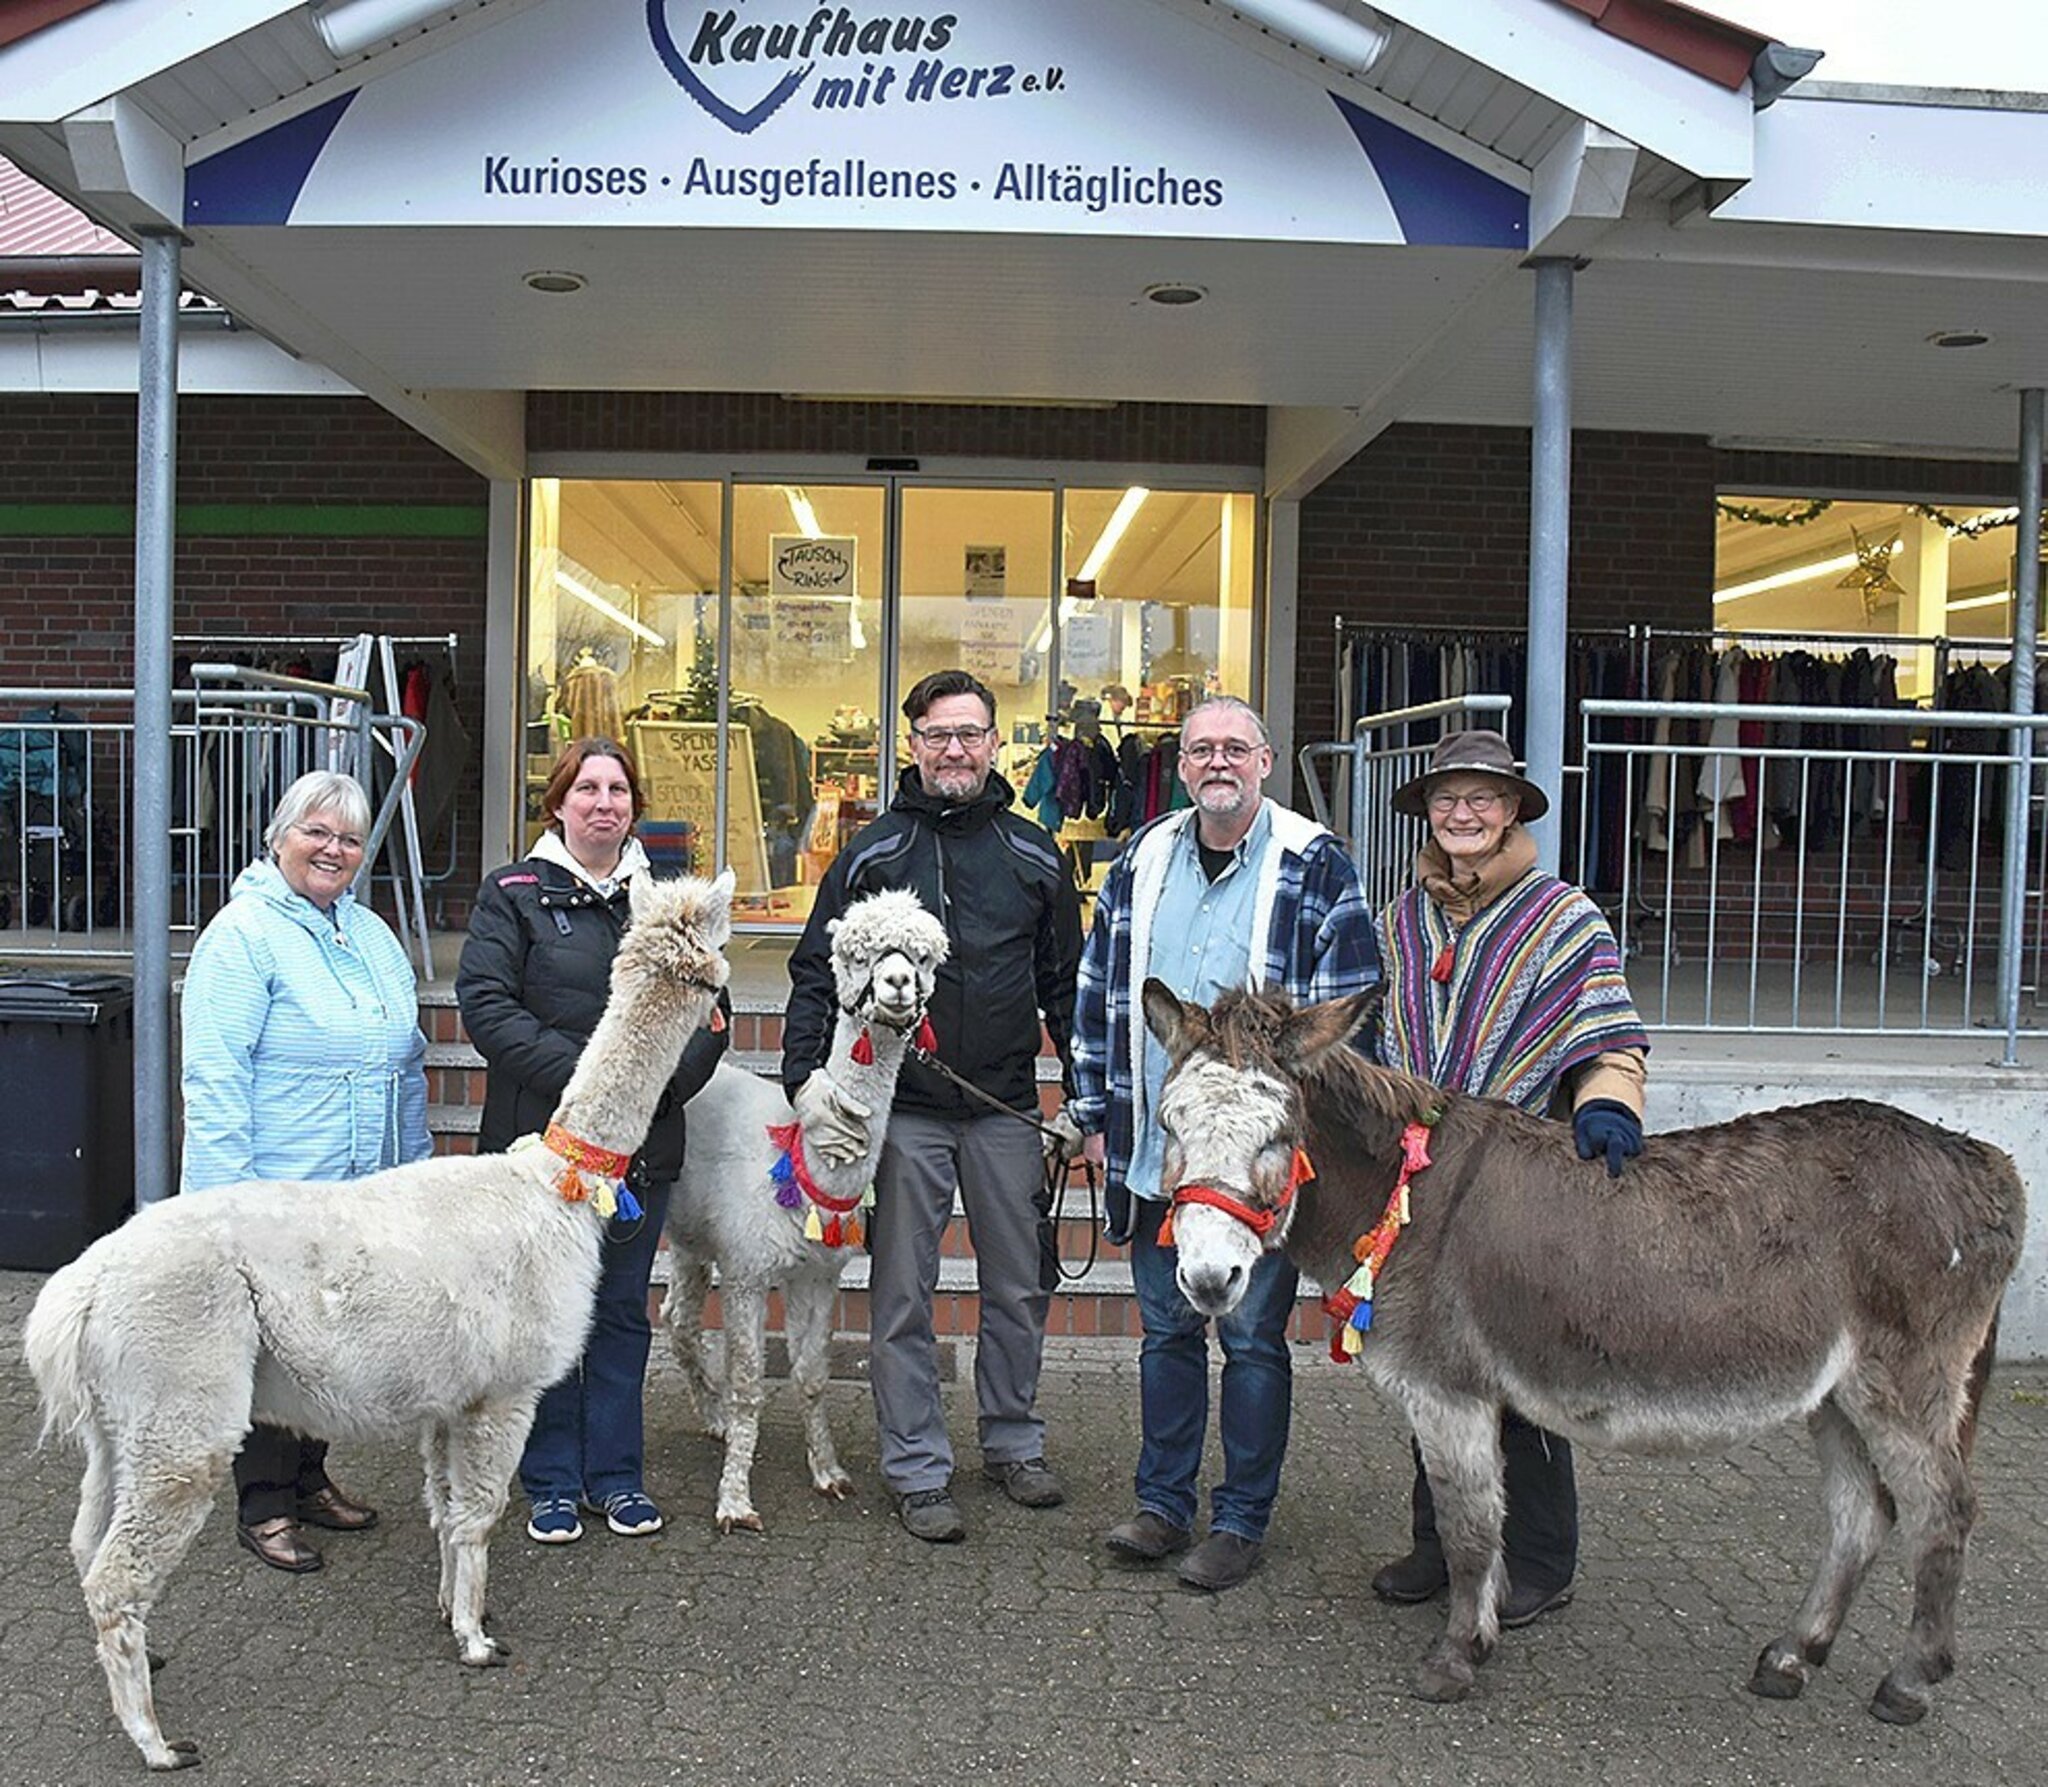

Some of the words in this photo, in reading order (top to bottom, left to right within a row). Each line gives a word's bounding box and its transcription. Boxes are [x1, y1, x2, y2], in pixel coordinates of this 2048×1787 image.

[689, 8, 957, 65] Kaufhaus
[812, 62, 896, 109] mit
[905, 59, 1016, 103] Herz
[1021, 66, 1065, 92] e.V.
[484, 156, 648, 195] Kurioses
[683, 157, 957, 206] Ausgefallenes
[993, 162, 1223, 212] Alltägliches
[784, 542, 842, 567] TAUSCH
[670, 732, 738, 751] SPENDN
